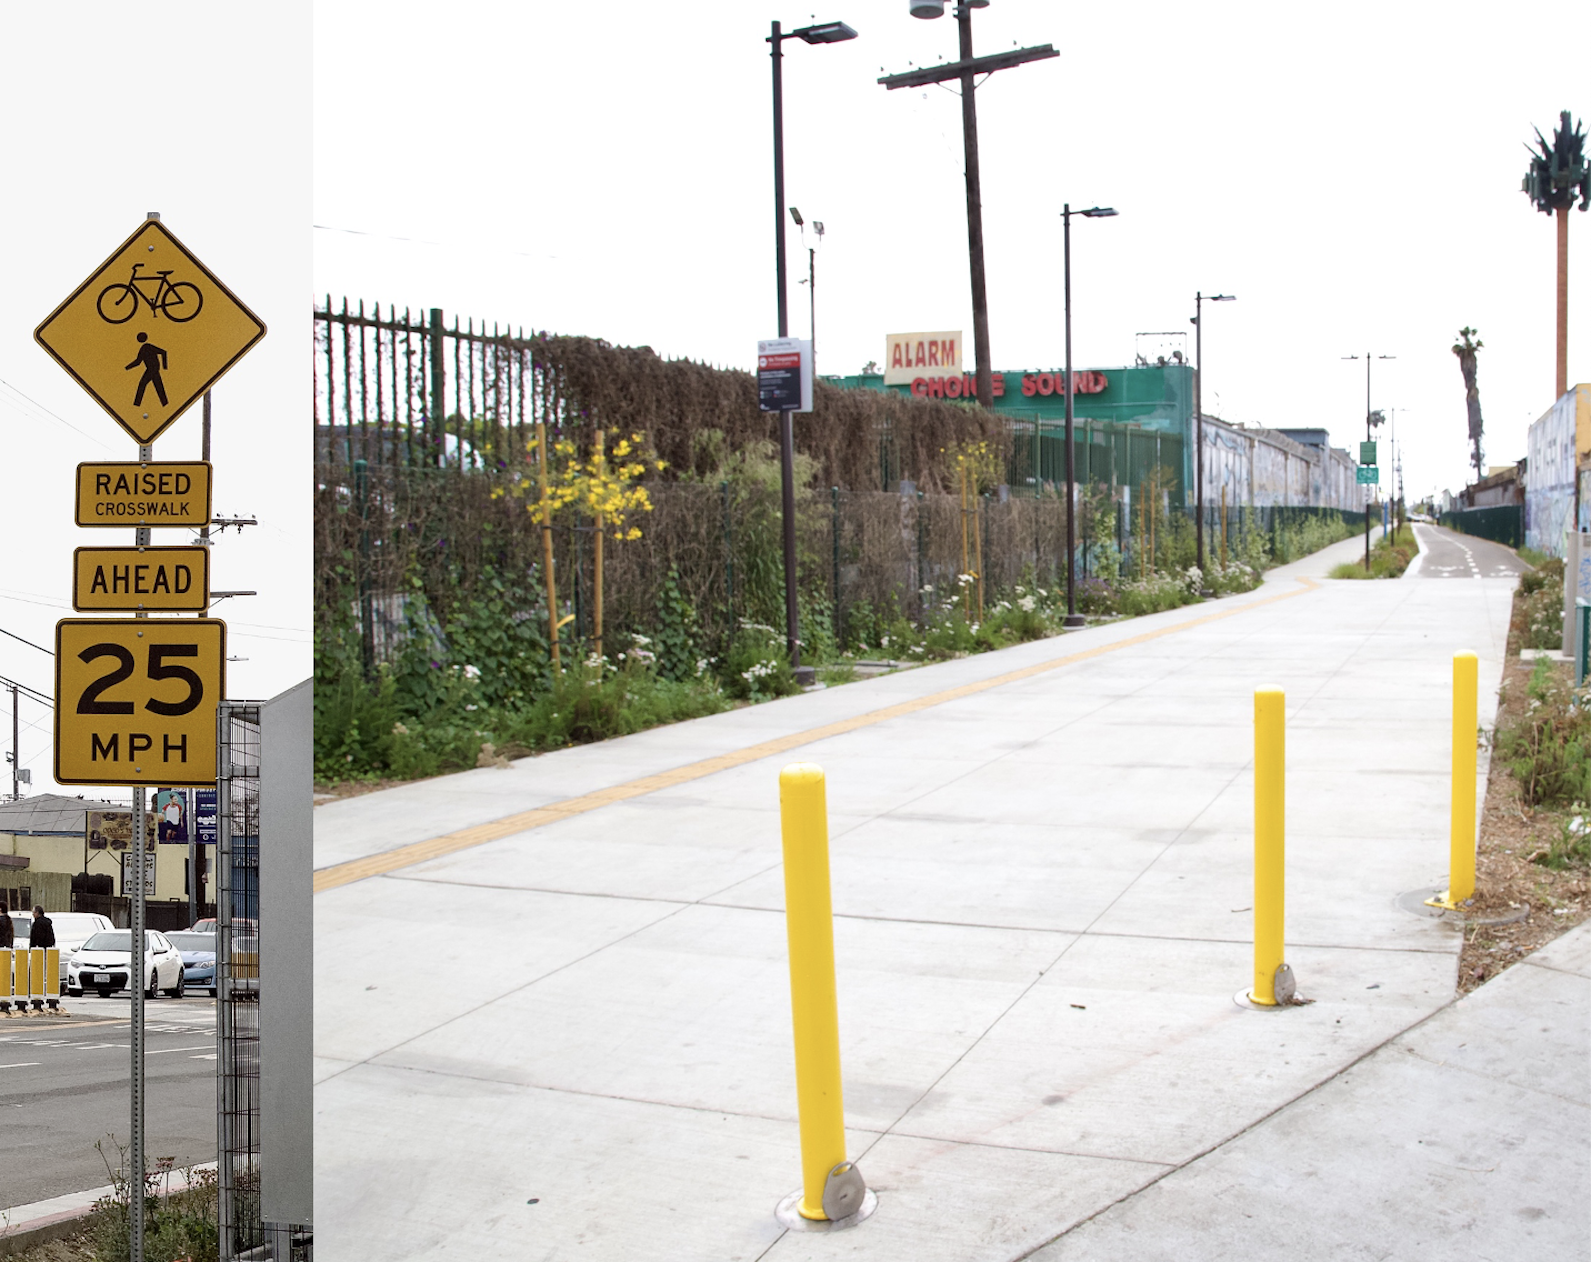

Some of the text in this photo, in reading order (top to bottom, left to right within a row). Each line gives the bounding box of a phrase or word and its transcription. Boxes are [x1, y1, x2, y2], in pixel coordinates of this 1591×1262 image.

[892, 340, 956, 370] ALARM
[1021, 370, 1108, 398] SOUND
[95, 473, 192, 495] RAISED
[95, 501, 190, 517] CROSSWALK
[91, 565, 192, 594] AHEAD
[76, 643, 204, 716] 25
[91, 733, 188, 763] MPH
